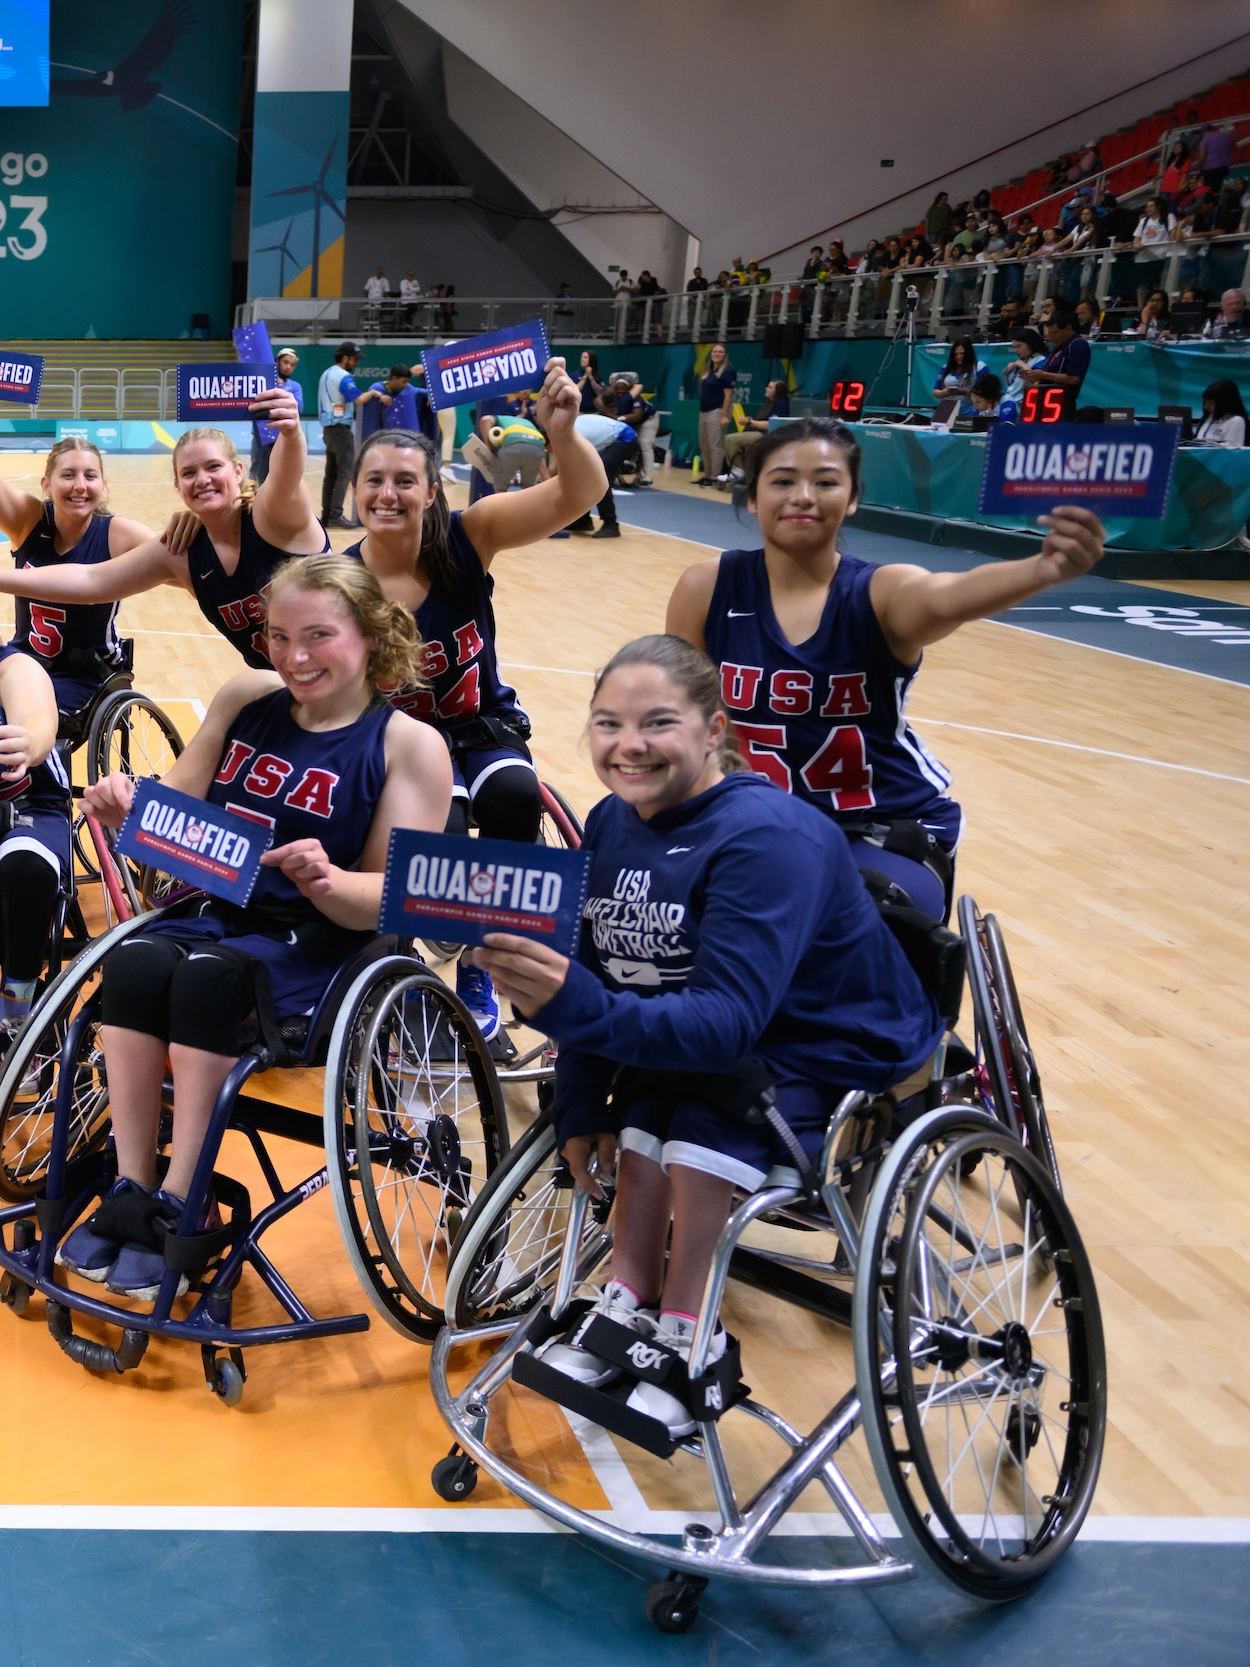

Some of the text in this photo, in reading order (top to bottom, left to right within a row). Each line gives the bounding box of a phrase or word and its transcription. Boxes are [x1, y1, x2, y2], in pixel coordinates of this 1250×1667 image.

[189, 375, 266, 400] QUALIFIED
[350, 367, 390, 378] JUEGO
[440, 347, 538, 394] QUALIFIED
[831, 382, 864, 411] 22
[1021, 388, 1064, 423] 55
[1004, 442, 1154, 482] QUALIFIED
[218, 578, 275, 631] US
[29, 602, 67, 658] 5
[719, 661, 872, 717] USA
[214, 739, 340, 819] USA
[728, 719, 876, 811] 54
[139, 800, 251, 868] QUALIFIED
[406, 854, 563, 913] QUALIFIED
[612, 868, 651, 902] USA
